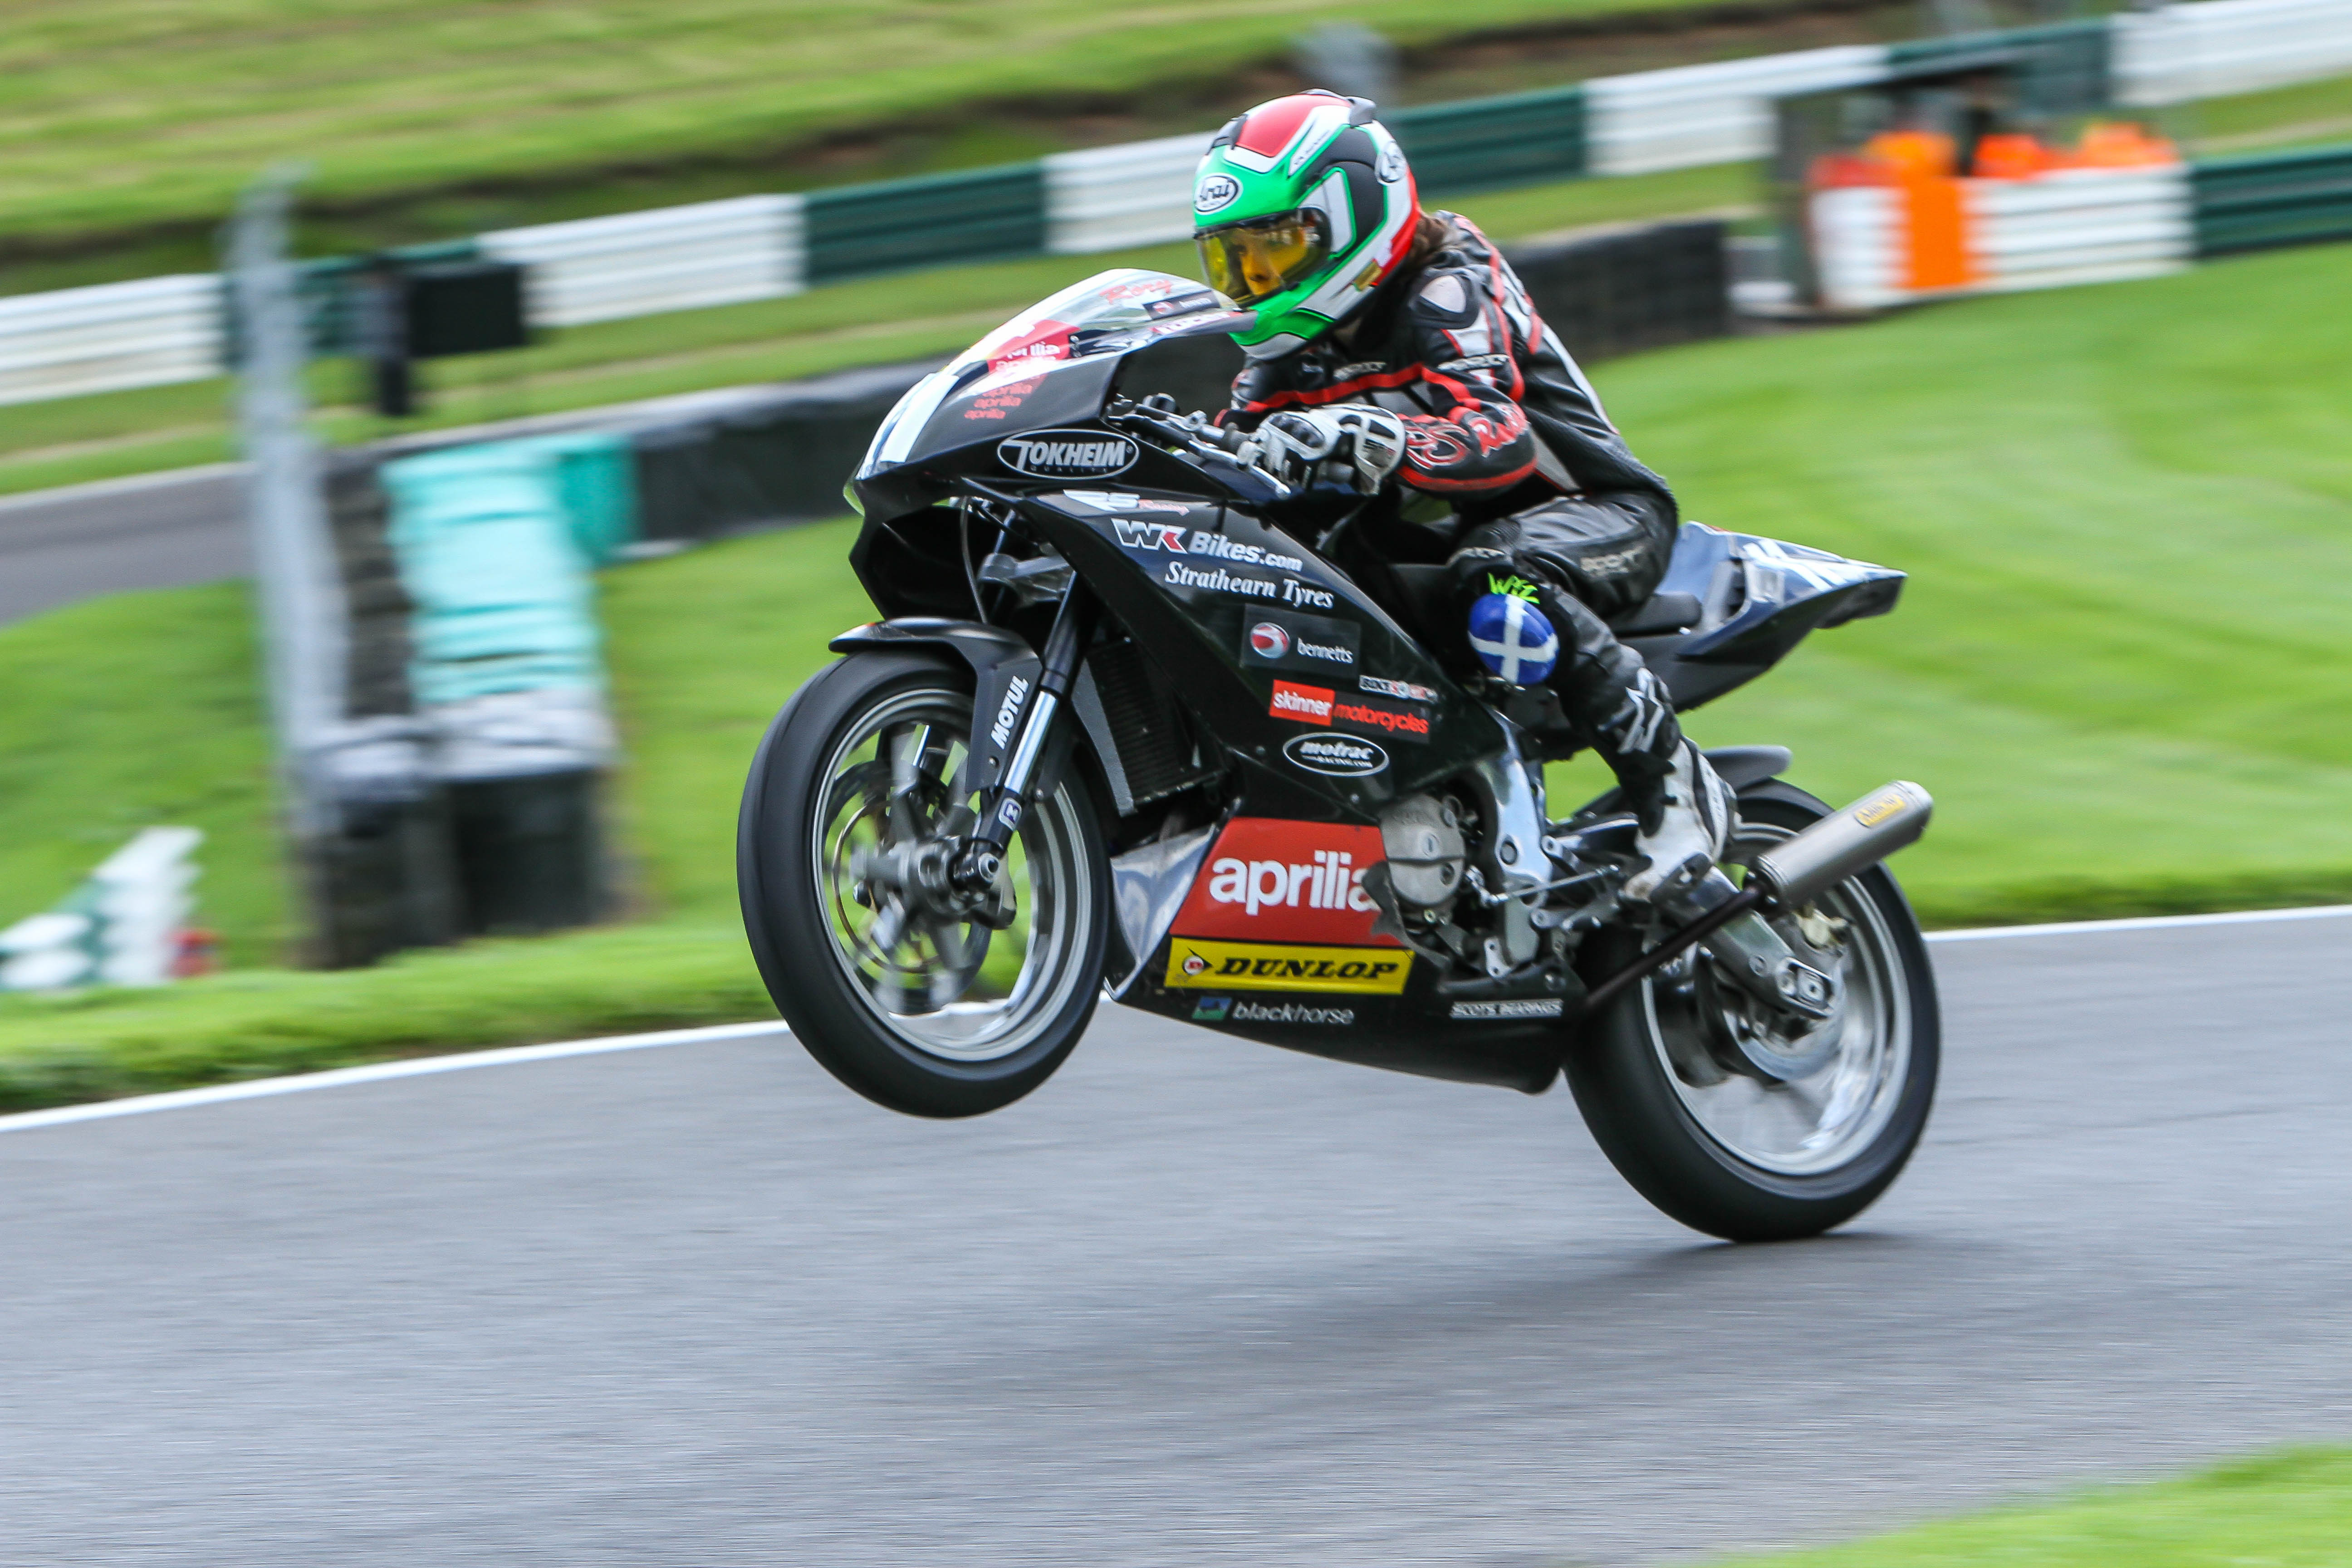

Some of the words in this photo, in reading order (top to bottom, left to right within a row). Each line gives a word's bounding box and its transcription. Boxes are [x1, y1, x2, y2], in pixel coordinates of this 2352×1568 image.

[1001, 439, 1127, 470] TOKHEIM
[1187, 530, 1303, 572] Bikes.com
[1164, 561, 1277, 598] Strathearn
[1282, 578, 1335, 608] Tyres
[1297, 637, 1354, 664] bennetts
[991, 675, 1029, 750] MOTUL
[1273, 690, 1333, 716] skinner
[1333, 703, 1429, 734] motorcycles
[1299, 741, 1375, 760] motrac
[1215, 957, 1399, 979] DUNLOP
[1232, 1001, 1355, 1024] blackhorse
